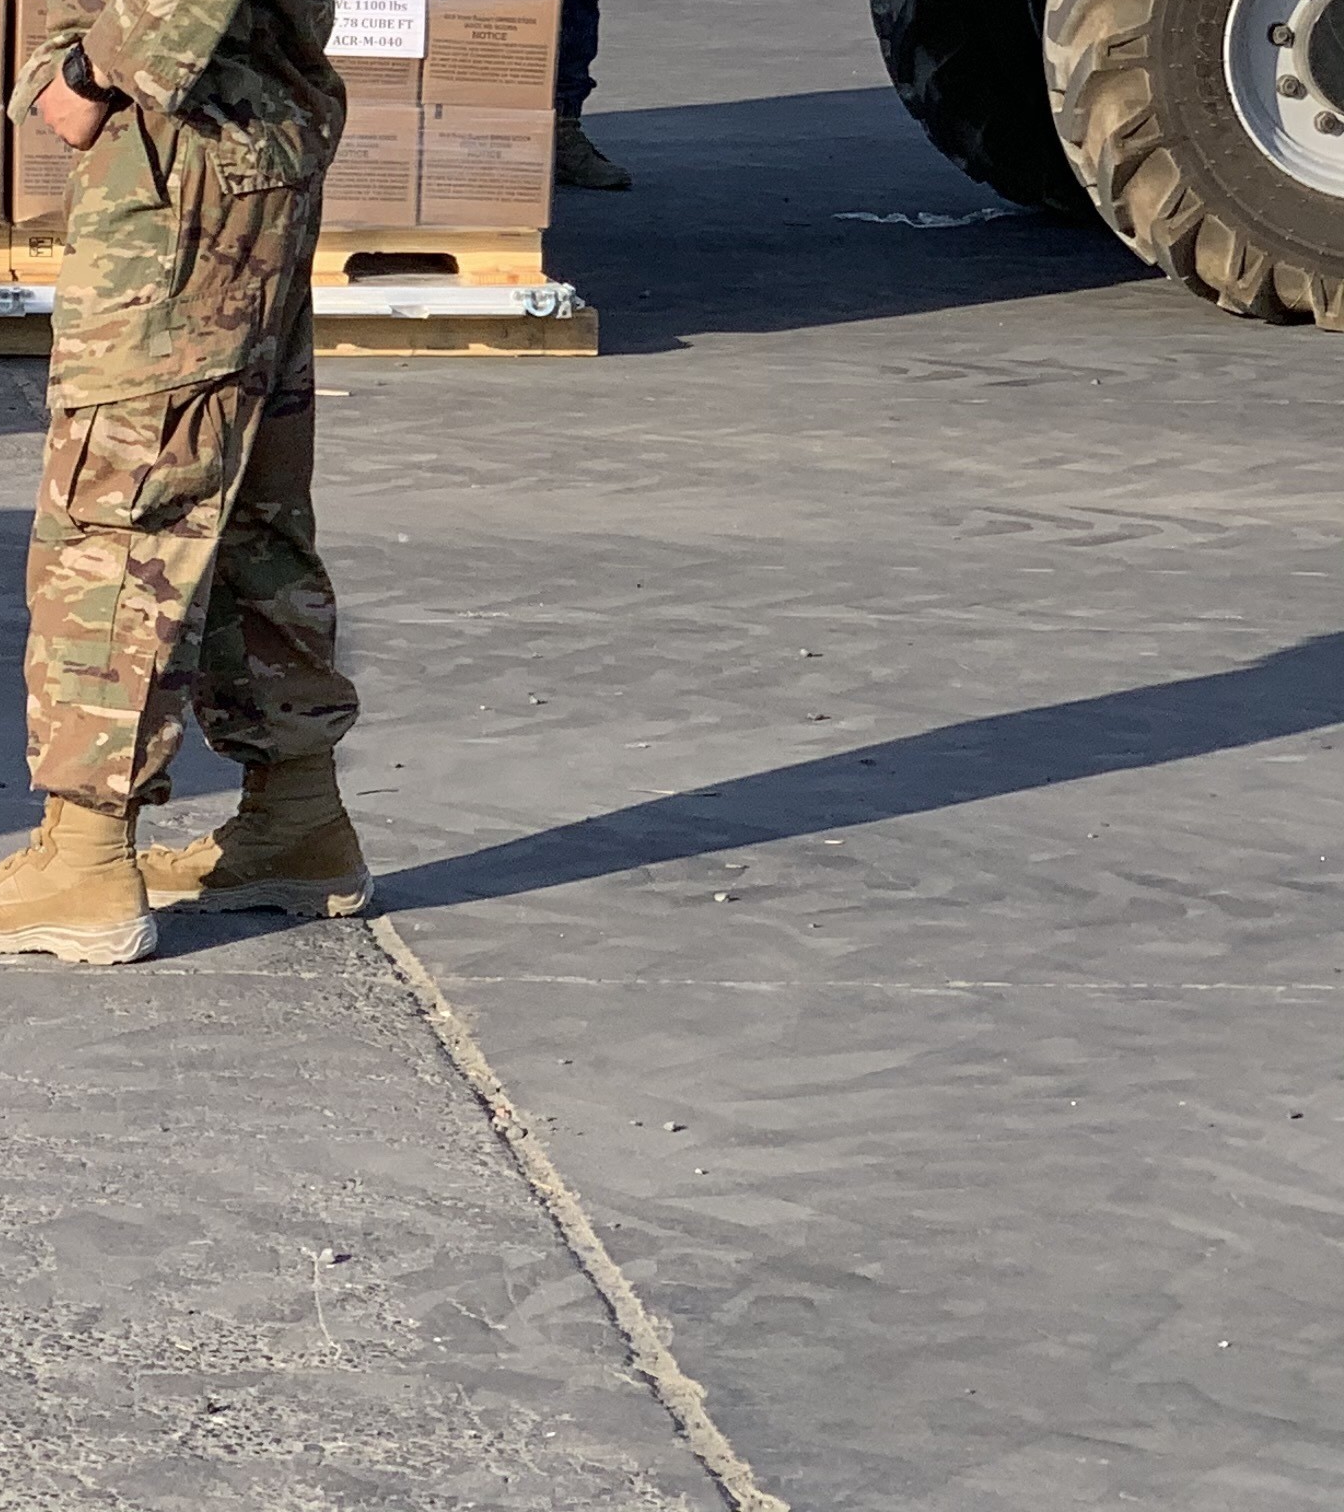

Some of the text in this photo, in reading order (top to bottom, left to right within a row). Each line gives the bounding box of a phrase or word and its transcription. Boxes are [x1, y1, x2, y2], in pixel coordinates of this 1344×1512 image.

[356, 0, 386, 12] 1100
[389, 0, 408, 12] lbs
[361, 18, 396, 30] CUBE
[398, 19, 414, 30] FT
[332, 35, 403, 48] ACR-M-040
[472, 31, 507, 41] NOTICE
